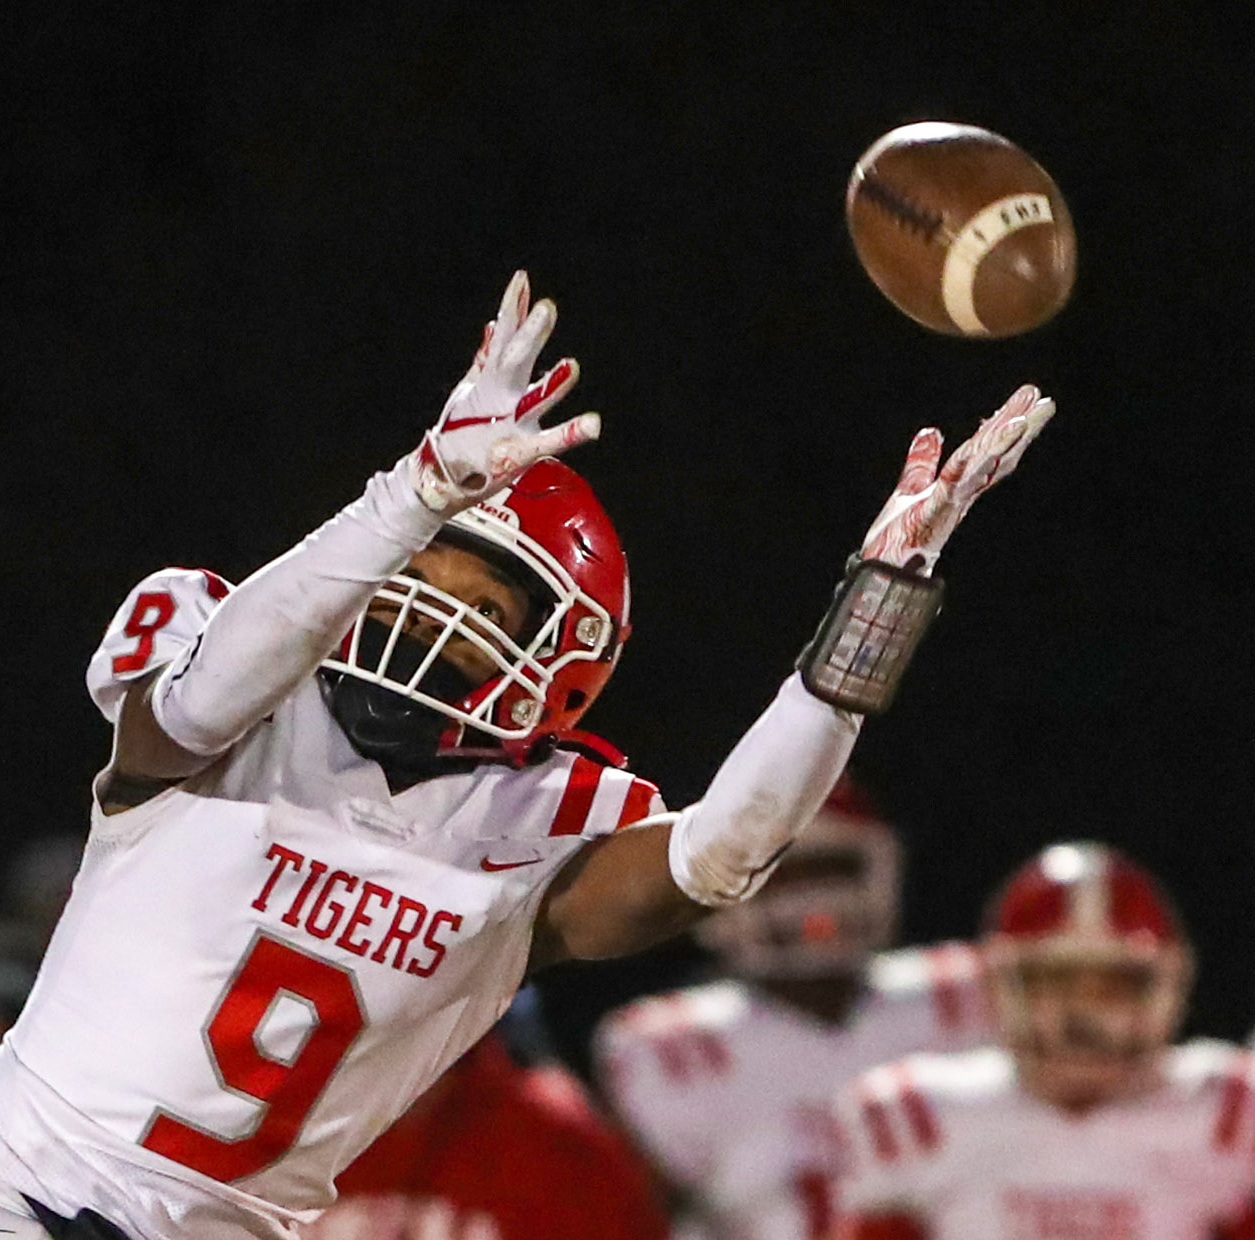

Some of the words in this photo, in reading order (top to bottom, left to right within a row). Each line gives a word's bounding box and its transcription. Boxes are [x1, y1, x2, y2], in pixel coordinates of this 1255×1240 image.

[109, 590, 179, 675] 9
[251, 842, 463, 978] TIGERS
[136, 927, 372, 1183] 9
